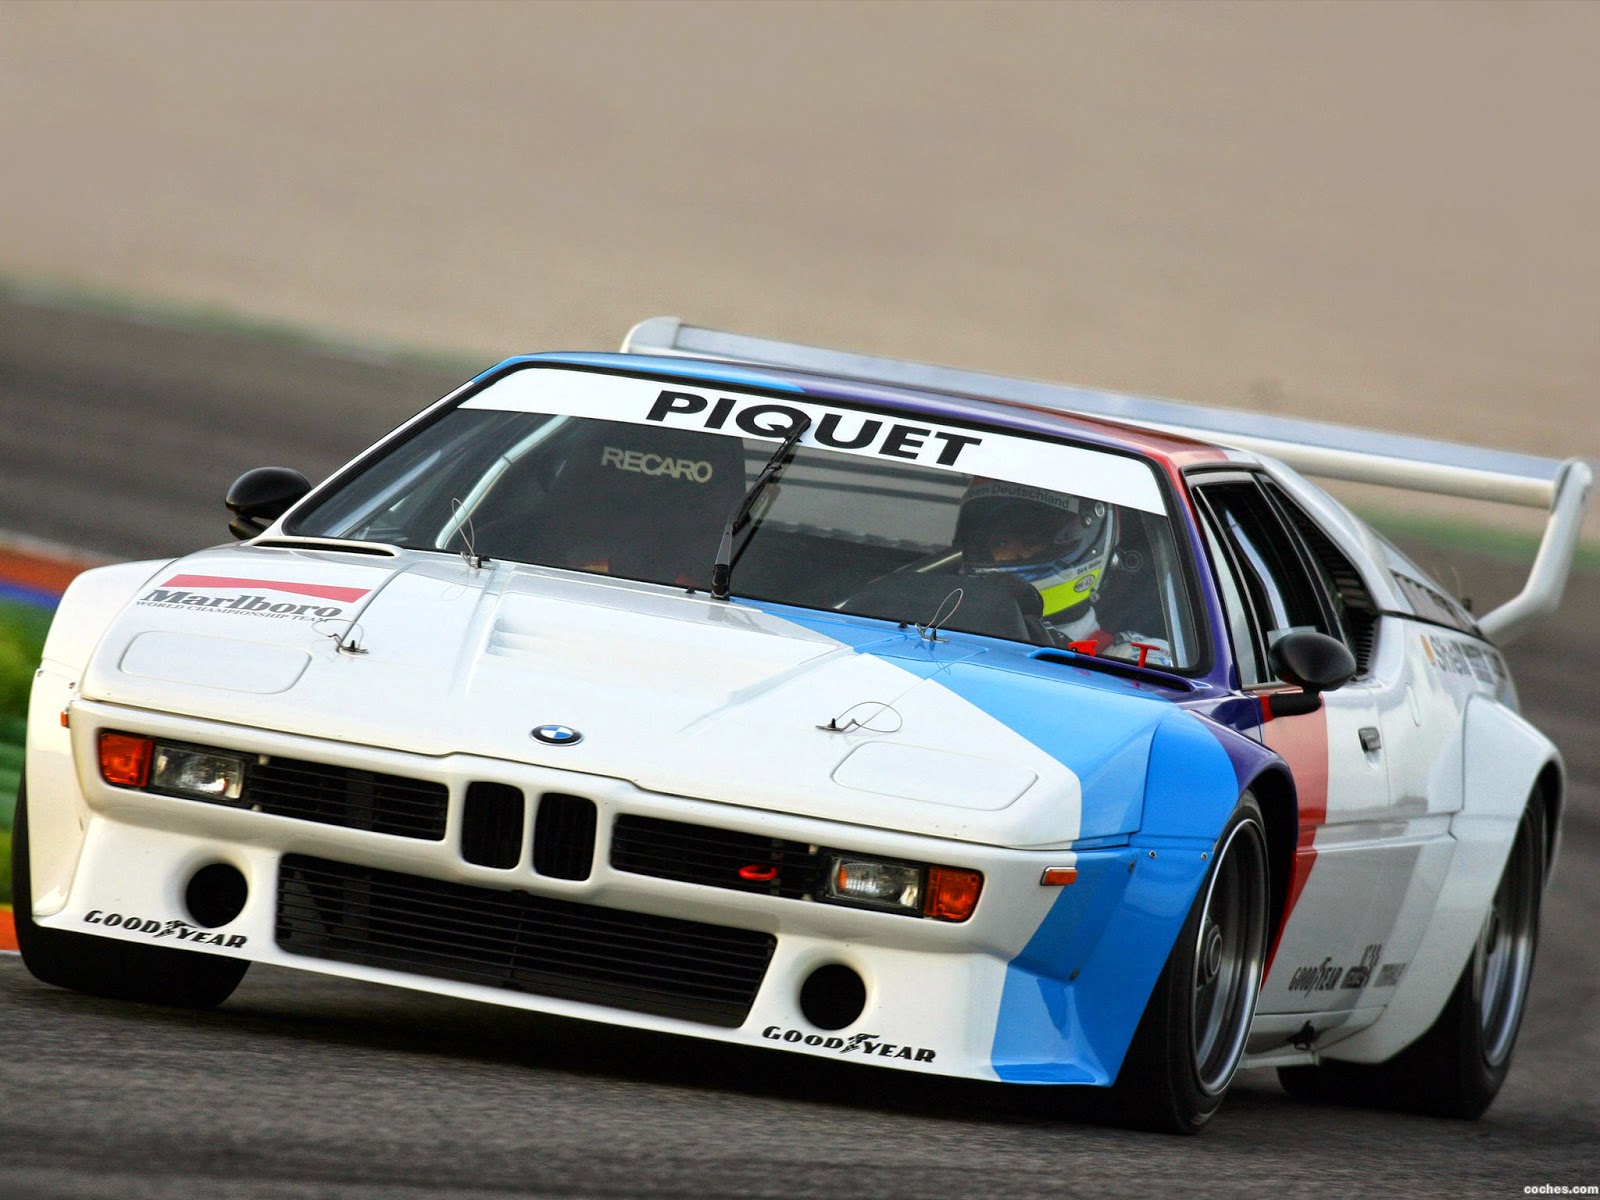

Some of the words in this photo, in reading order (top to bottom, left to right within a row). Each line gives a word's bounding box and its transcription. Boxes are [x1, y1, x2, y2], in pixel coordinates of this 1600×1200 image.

[645, 389, 982, 467] PIQUET
[601, 446, 713, 483] RECARO
[992, 484, 1070, 510] Deutschland
[135, 600, 186, 610] WORLD
[187, 606, 289, 619] CHAMPIONSHIP
[140, 589, 342, 617] Marlboro
[84, 910, 248, 948] GOODYEAR
[762, 1025, 936, 1063] GOODYEAR
